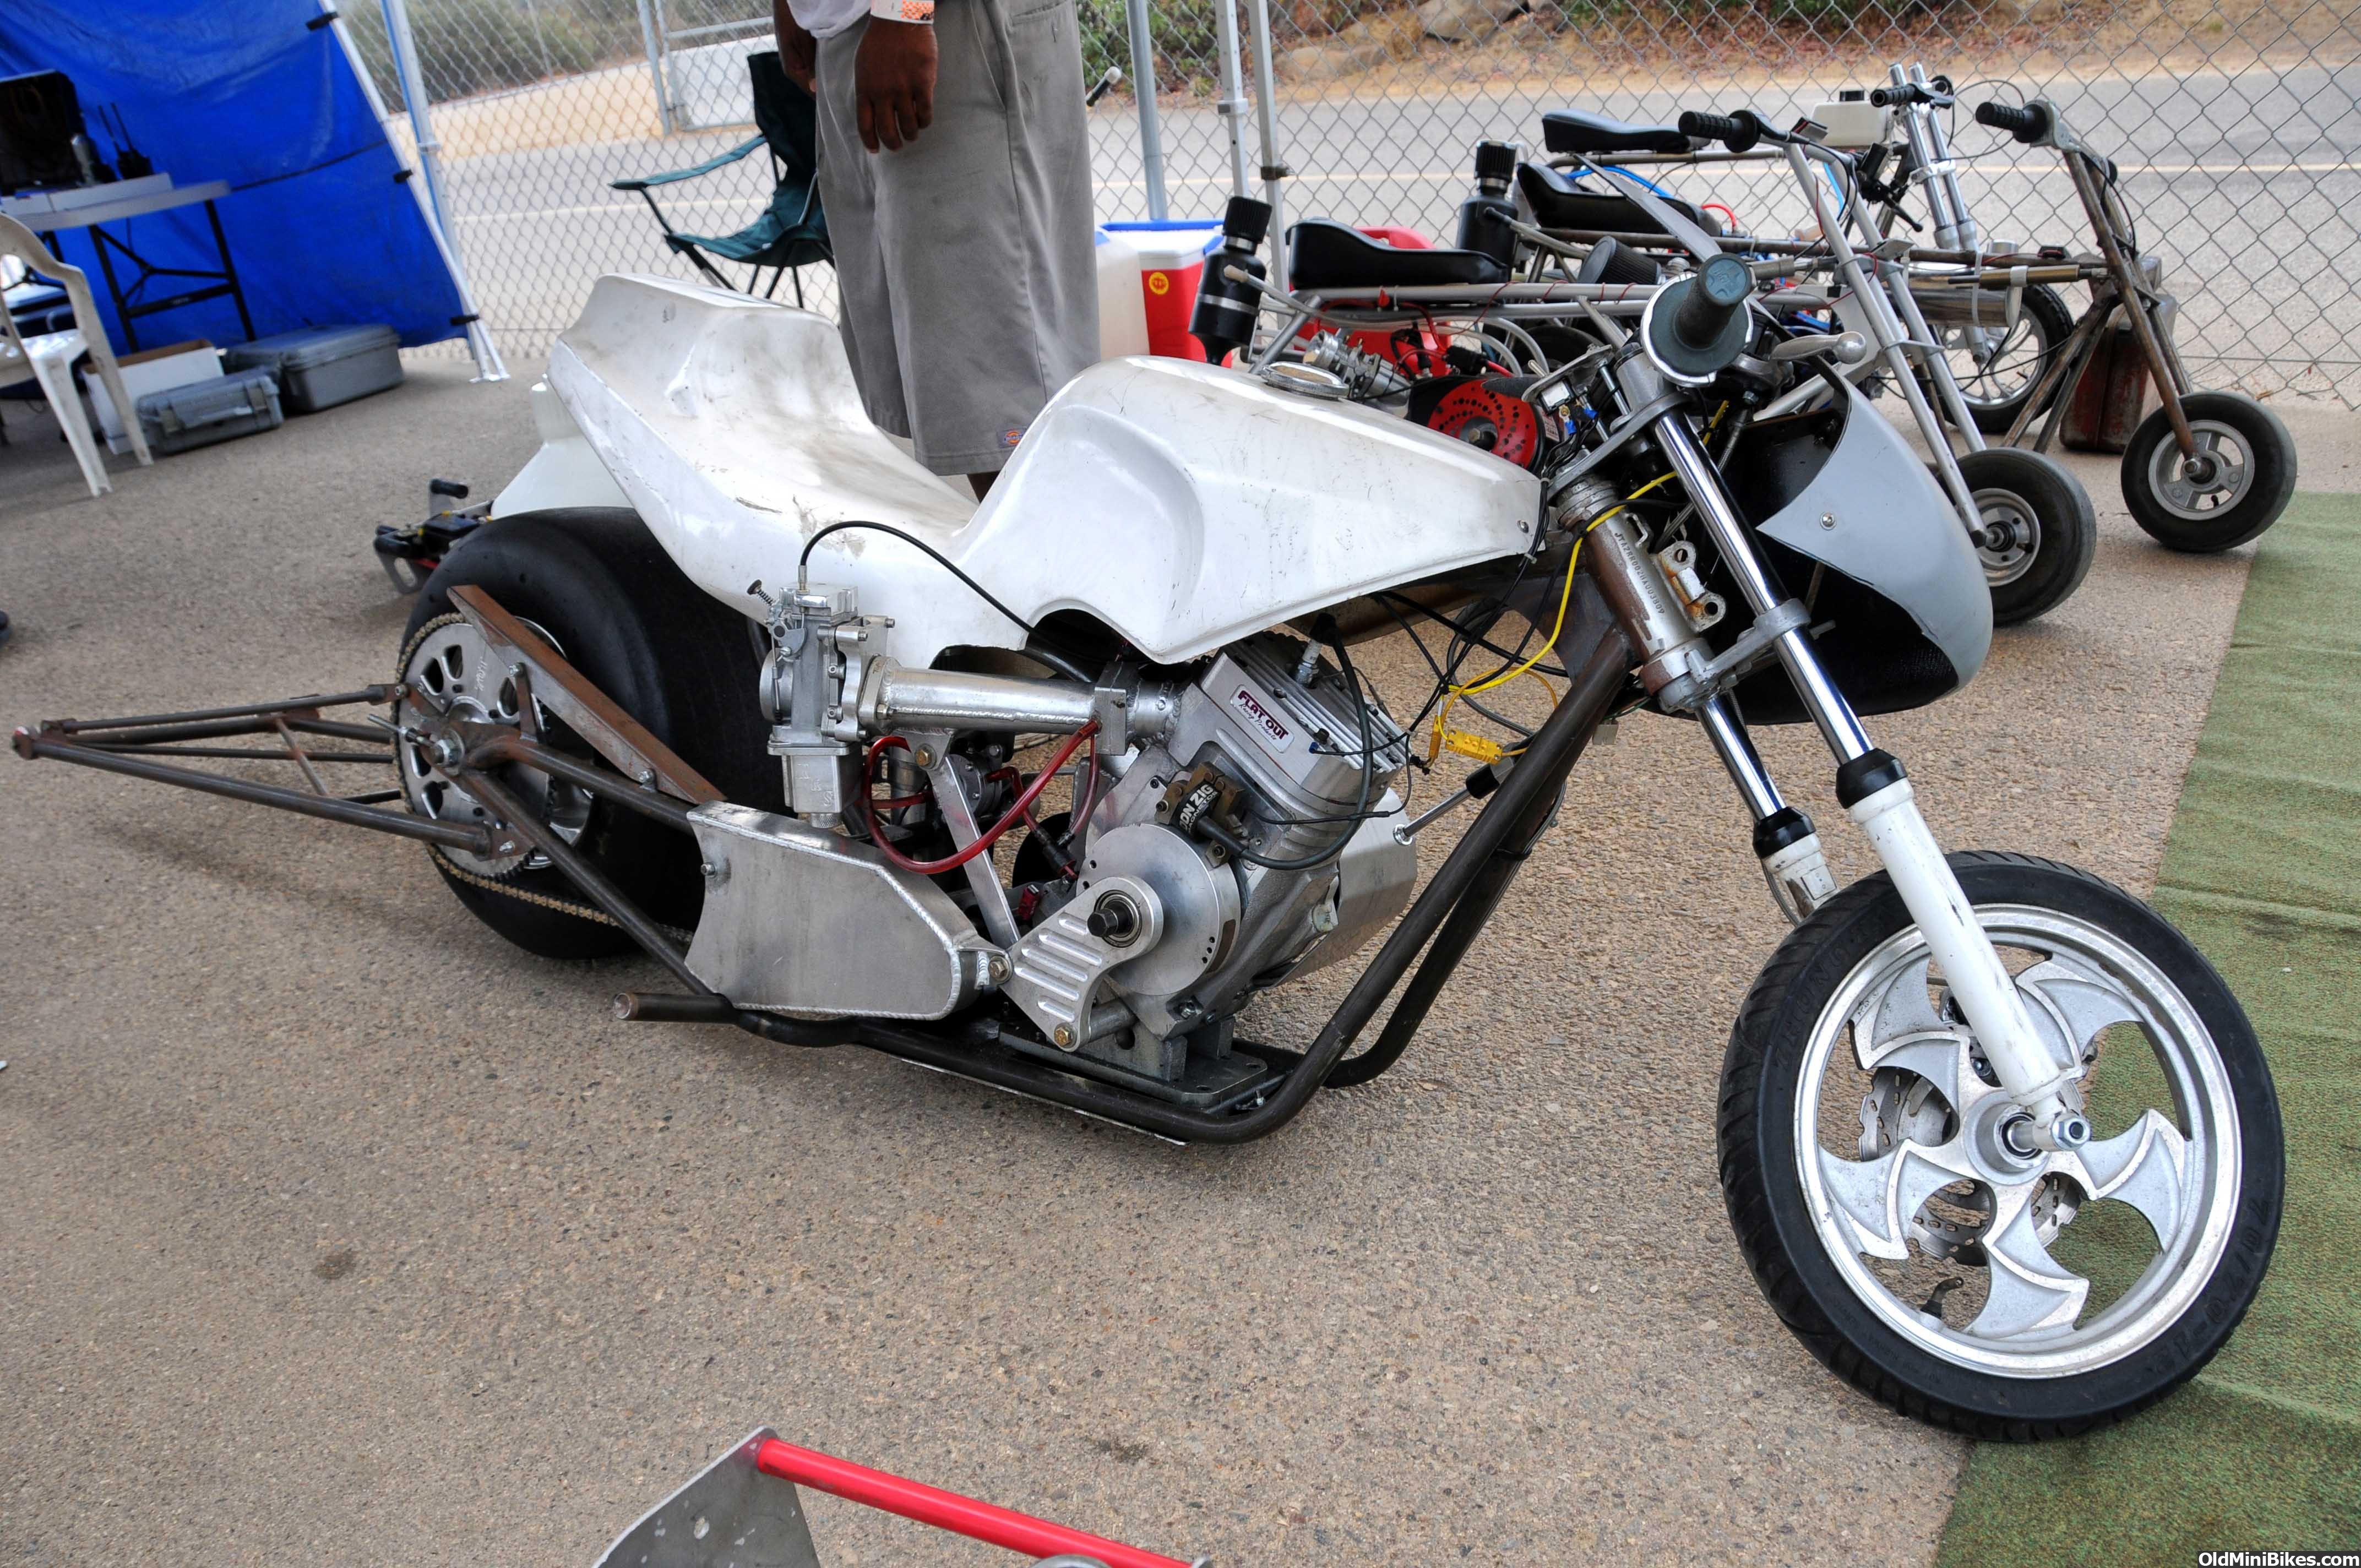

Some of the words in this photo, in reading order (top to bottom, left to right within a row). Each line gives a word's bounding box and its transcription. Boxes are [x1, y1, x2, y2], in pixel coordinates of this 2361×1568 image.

[1238, 690, 1265, 718] FLAT
[1266, 718, 1289, 740] OUT
[1238, 704, 1254, 719] Racing
[1255, 719, 1276, 740] Products
[1179, 803, 1195, 831] DON
[1190, 784, 1214, 806] ZIG
